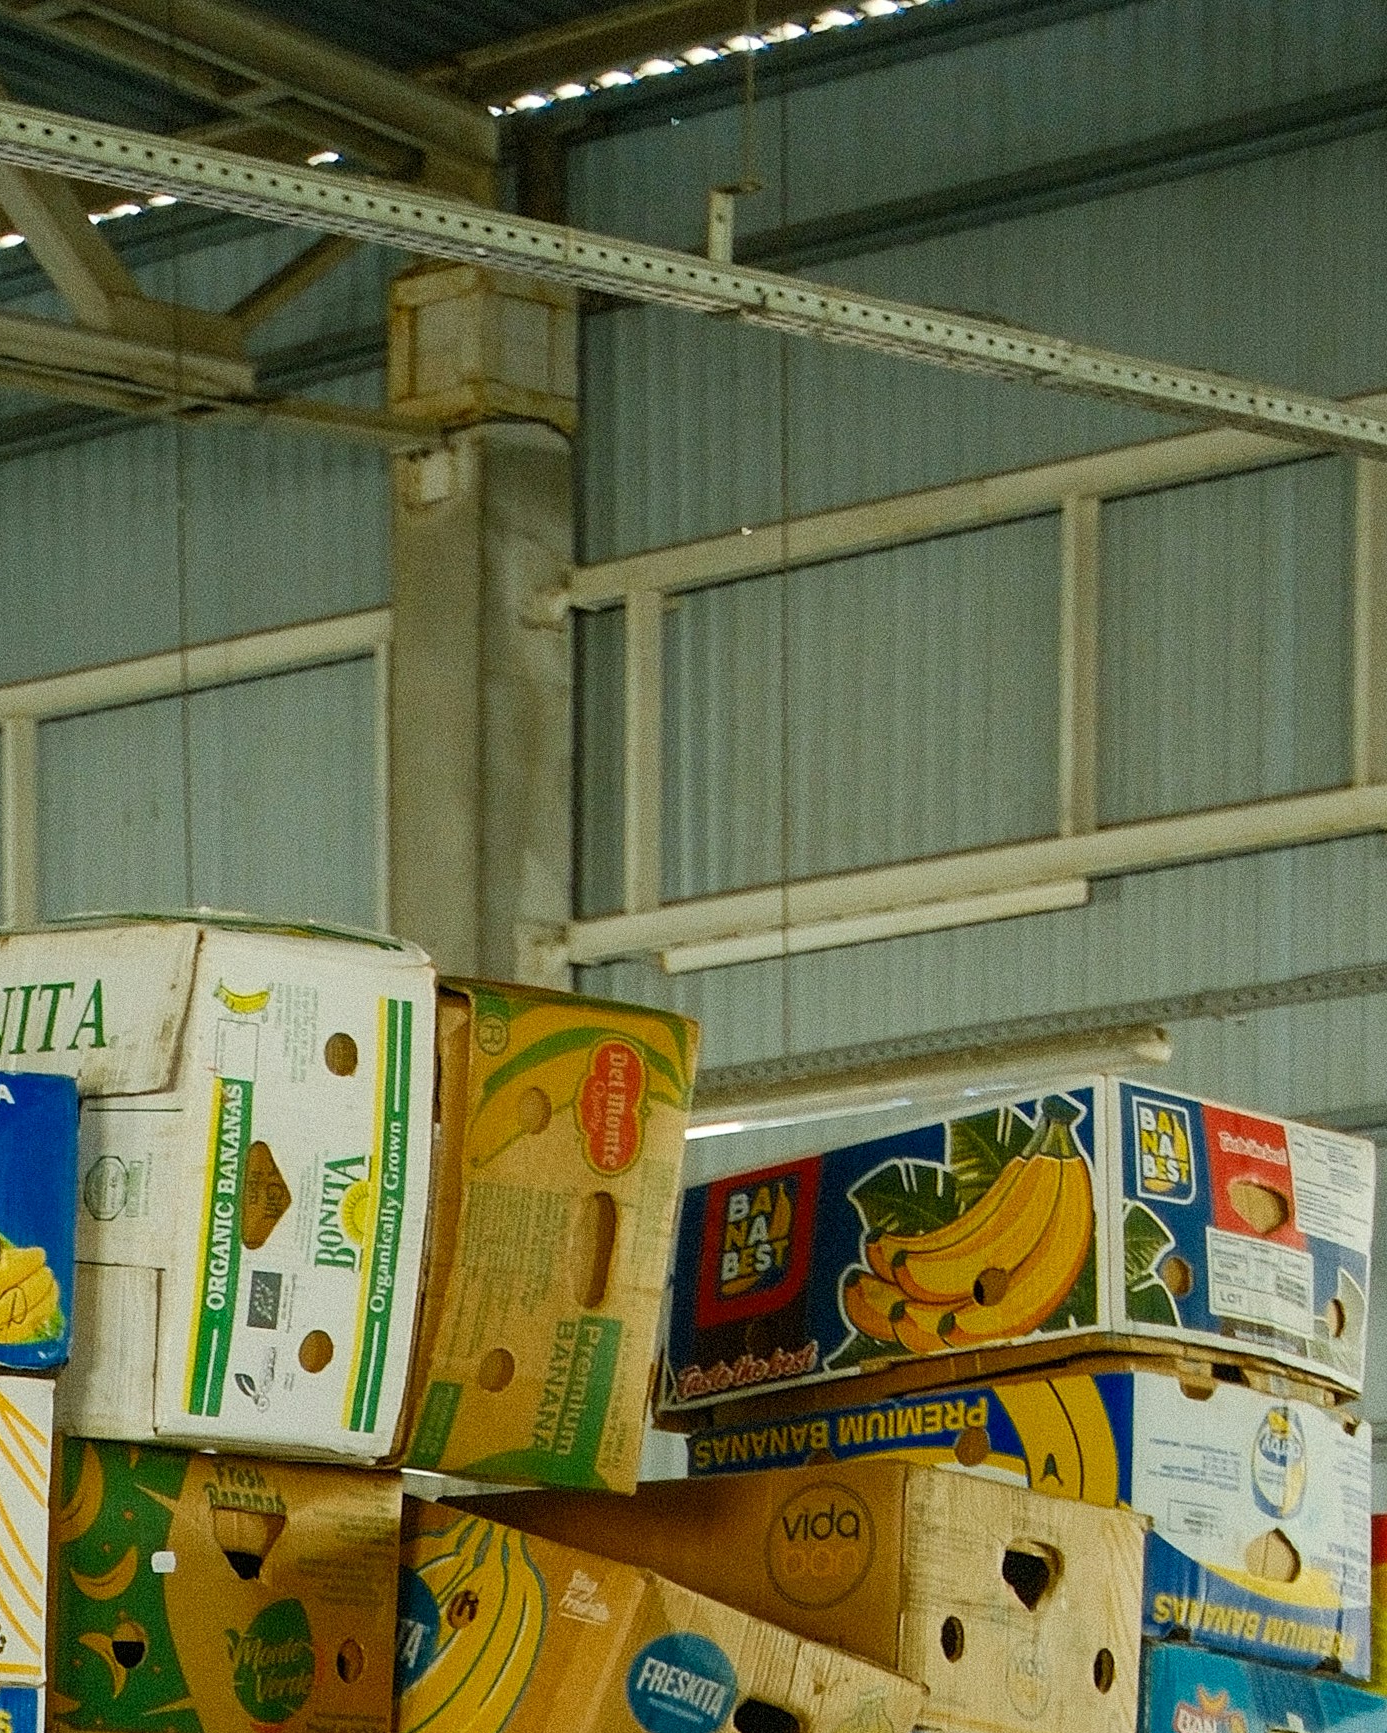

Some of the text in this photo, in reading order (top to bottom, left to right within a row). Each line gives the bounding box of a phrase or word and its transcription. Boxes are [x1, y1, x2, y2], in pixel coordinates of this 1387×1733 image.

[205, 1081, 245, 1314] ORGANIC BANANAS
[313, 1154, 370, 1271] BONITA
[693, 1397, 989, 1470] PREMIUM BANANAS
[783, 1504, 861, 1542] vida
[635, 1660, 725, 1718] FRESKITA
